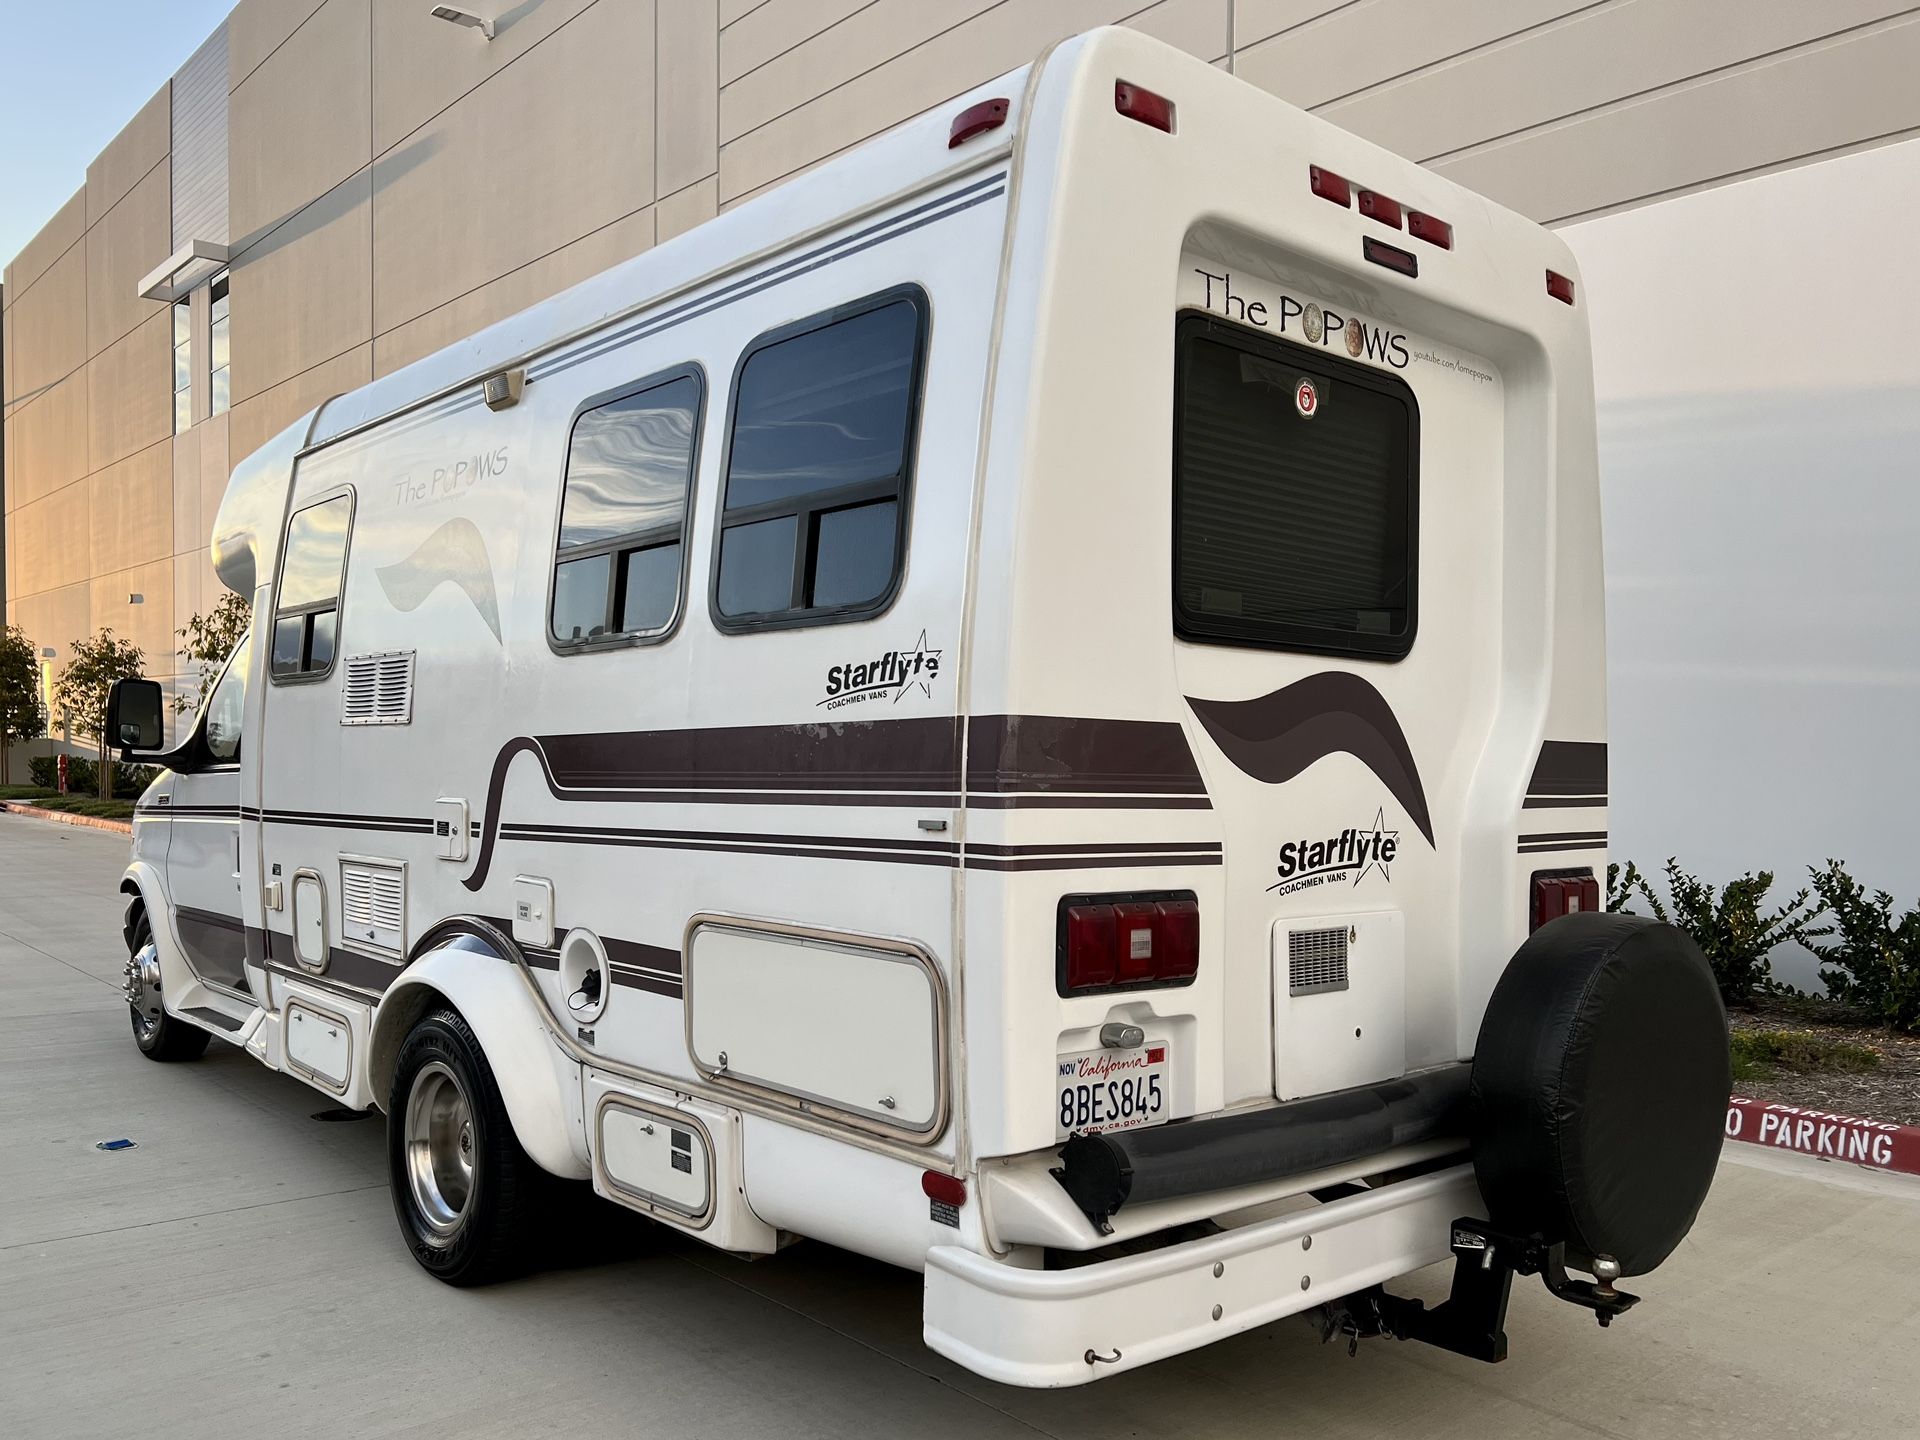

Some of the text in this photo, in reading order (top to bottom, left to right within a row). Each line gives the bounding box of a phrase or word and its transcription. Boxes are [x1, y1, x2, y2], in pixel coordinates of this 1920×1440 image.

[1195, 268, 1268, 327] The
[395, 472, 427, 506] The
[826, 651, 940, 695] Starflyte
[827, 689, 888, 710] COACHMEN VANS
[1277, 828, 1397, 878] Starflyte
[1279, 871, 1347, 896] COACHMEN VANS
[1060, 1063, 1076, 1076] NOV
[1078, 1055, 1149, 1080] California
[1060, 1073, 1162, 1128] 8BES845
[1765, 1103, 1902, 1131] PARKING
[1082, 1117, 1143, 1134] dmv.ca.gov
[1758, 1112, 1893, 1165] PARKING
